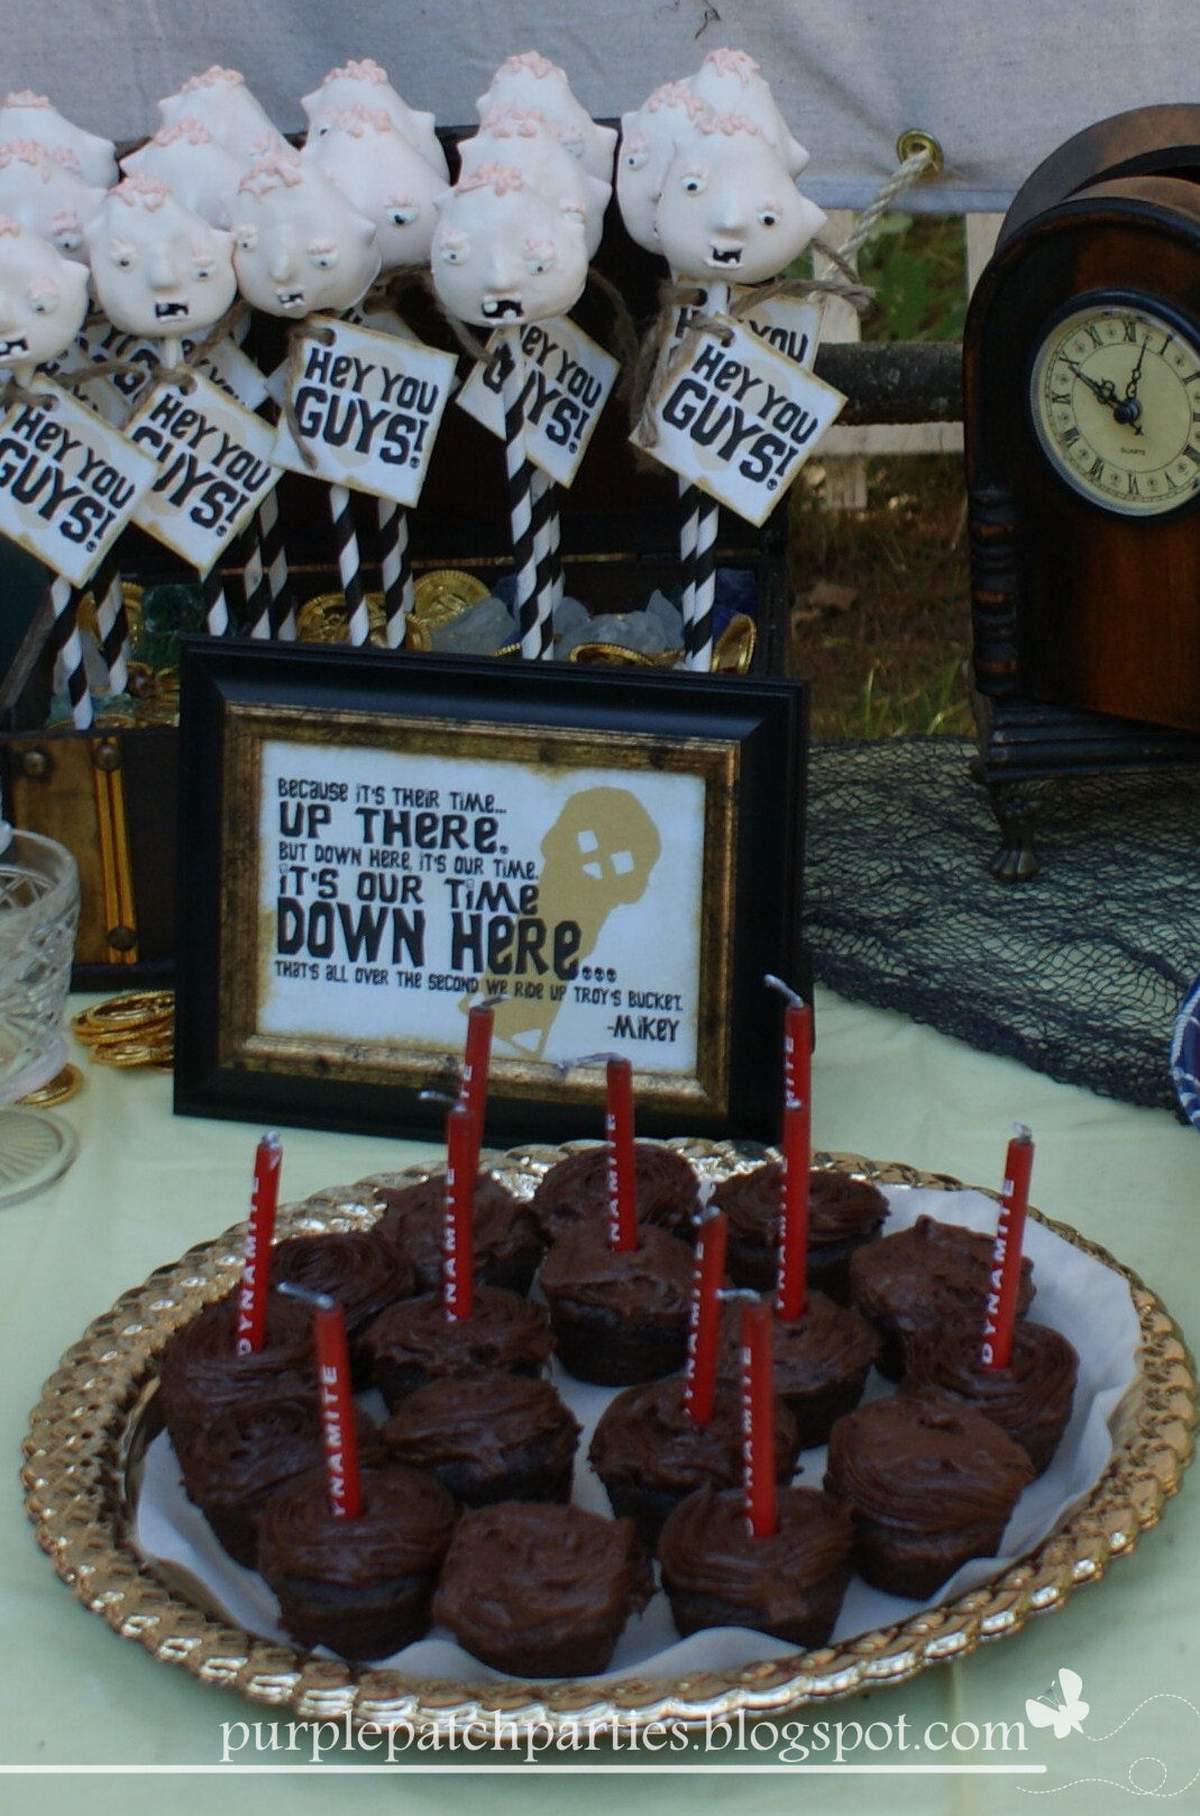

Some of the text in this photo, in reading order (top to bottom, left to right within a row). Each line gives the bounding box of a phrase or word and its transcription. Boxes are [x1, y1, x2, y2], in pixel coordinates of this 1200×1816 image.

[380, 366, 439, 415] YOU
[555, 350, 602, 409] YOU
[294, 386, 429, 469] GUYS!
[662, 378, 799, 491] GUYS!
[758, 384, 818, 444] YOU
[77, 448, 136, 509] YOU
[211, 432, 271, 493] YOU
[0, 438, 117, 552] GUYS!
[280, 801, 332, 839] UP
[279, 841, 307, 862] BUT
[315, 844, 362, 867] DOWN
[454, 856, 484, 876] OUR
[357, 870, 424, 904] OUR
[277, 896, 426, 968] DOWN
[550, 982, 568, 1001] UP
[320, 1363, 347, 1517] YNAMITE
